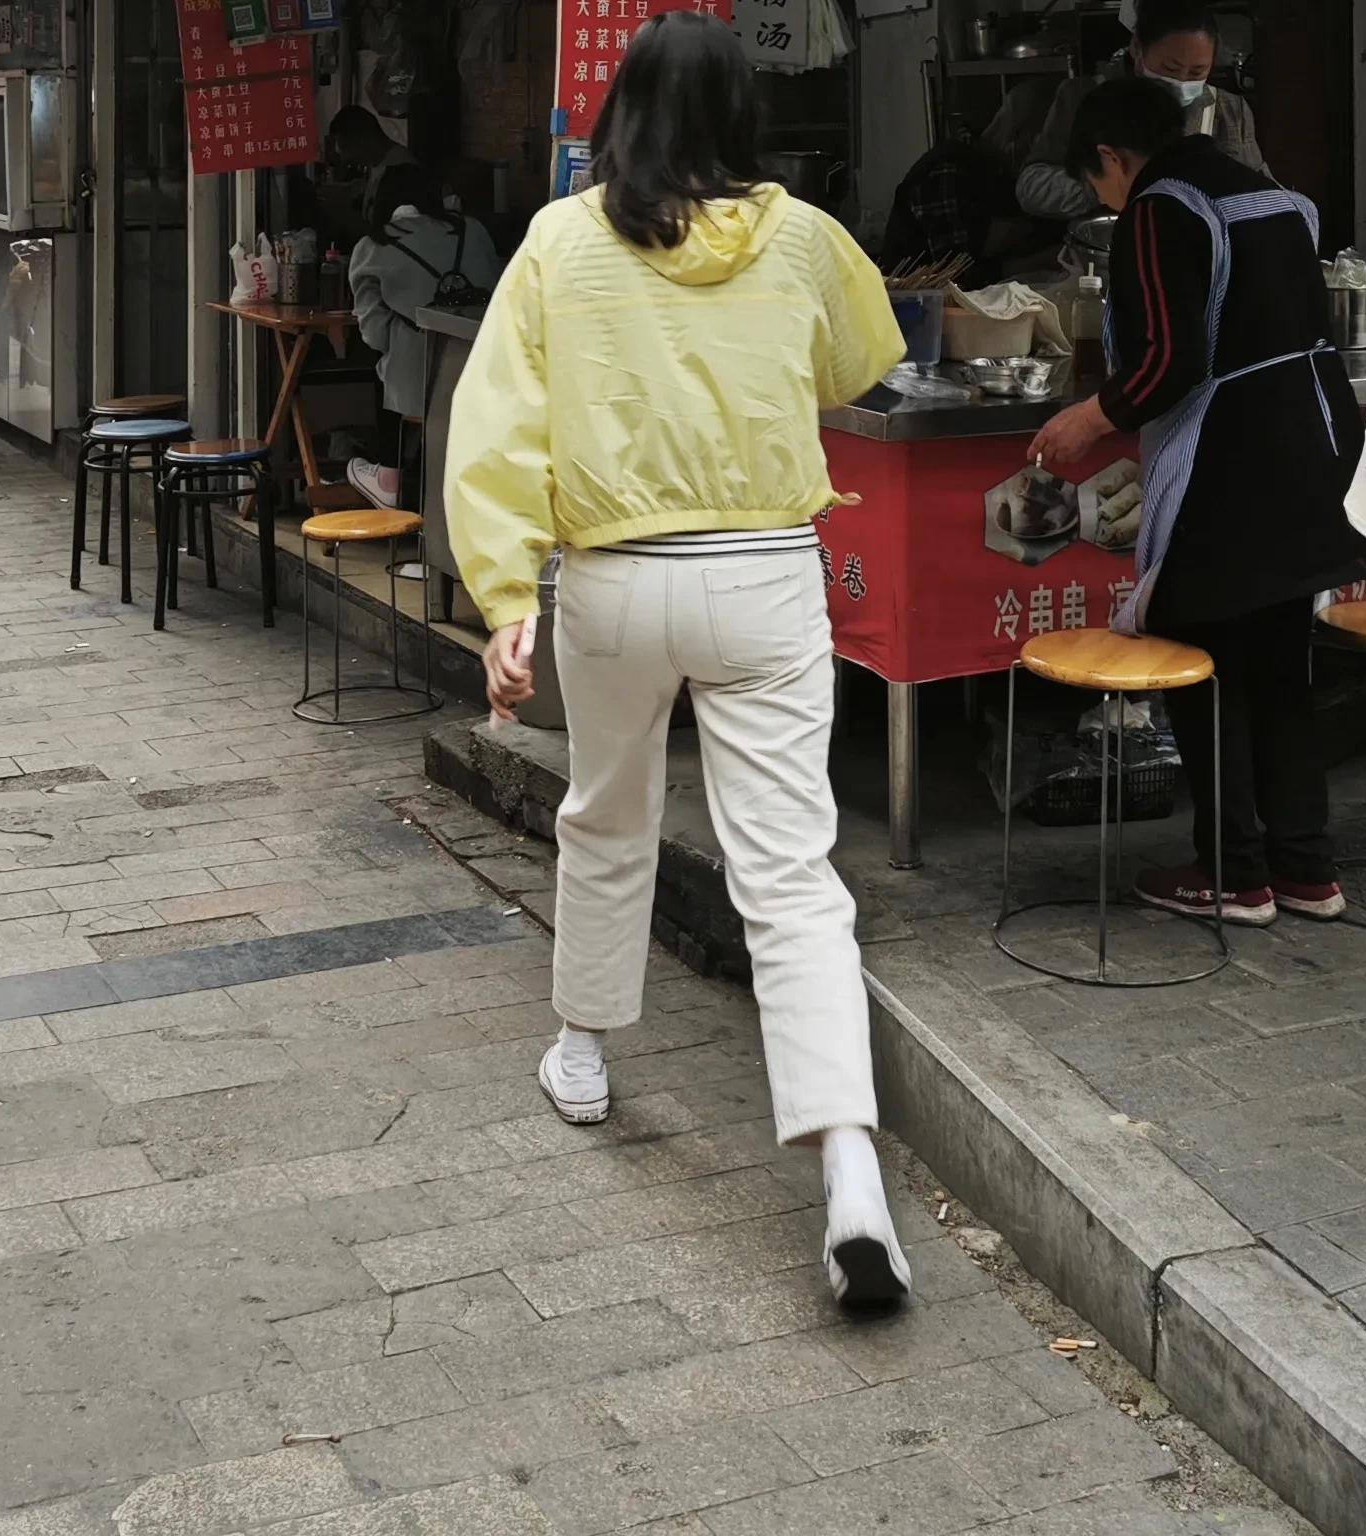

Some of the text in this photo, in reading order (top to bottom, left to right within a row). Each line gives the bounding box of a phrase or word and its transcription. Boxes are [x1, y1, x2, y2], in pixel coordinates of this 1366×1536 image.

[284, 96, 304, 109] 6元
[286, 116, 305, 129] 6元
[995, 580, 1086, 642] 冷串串
